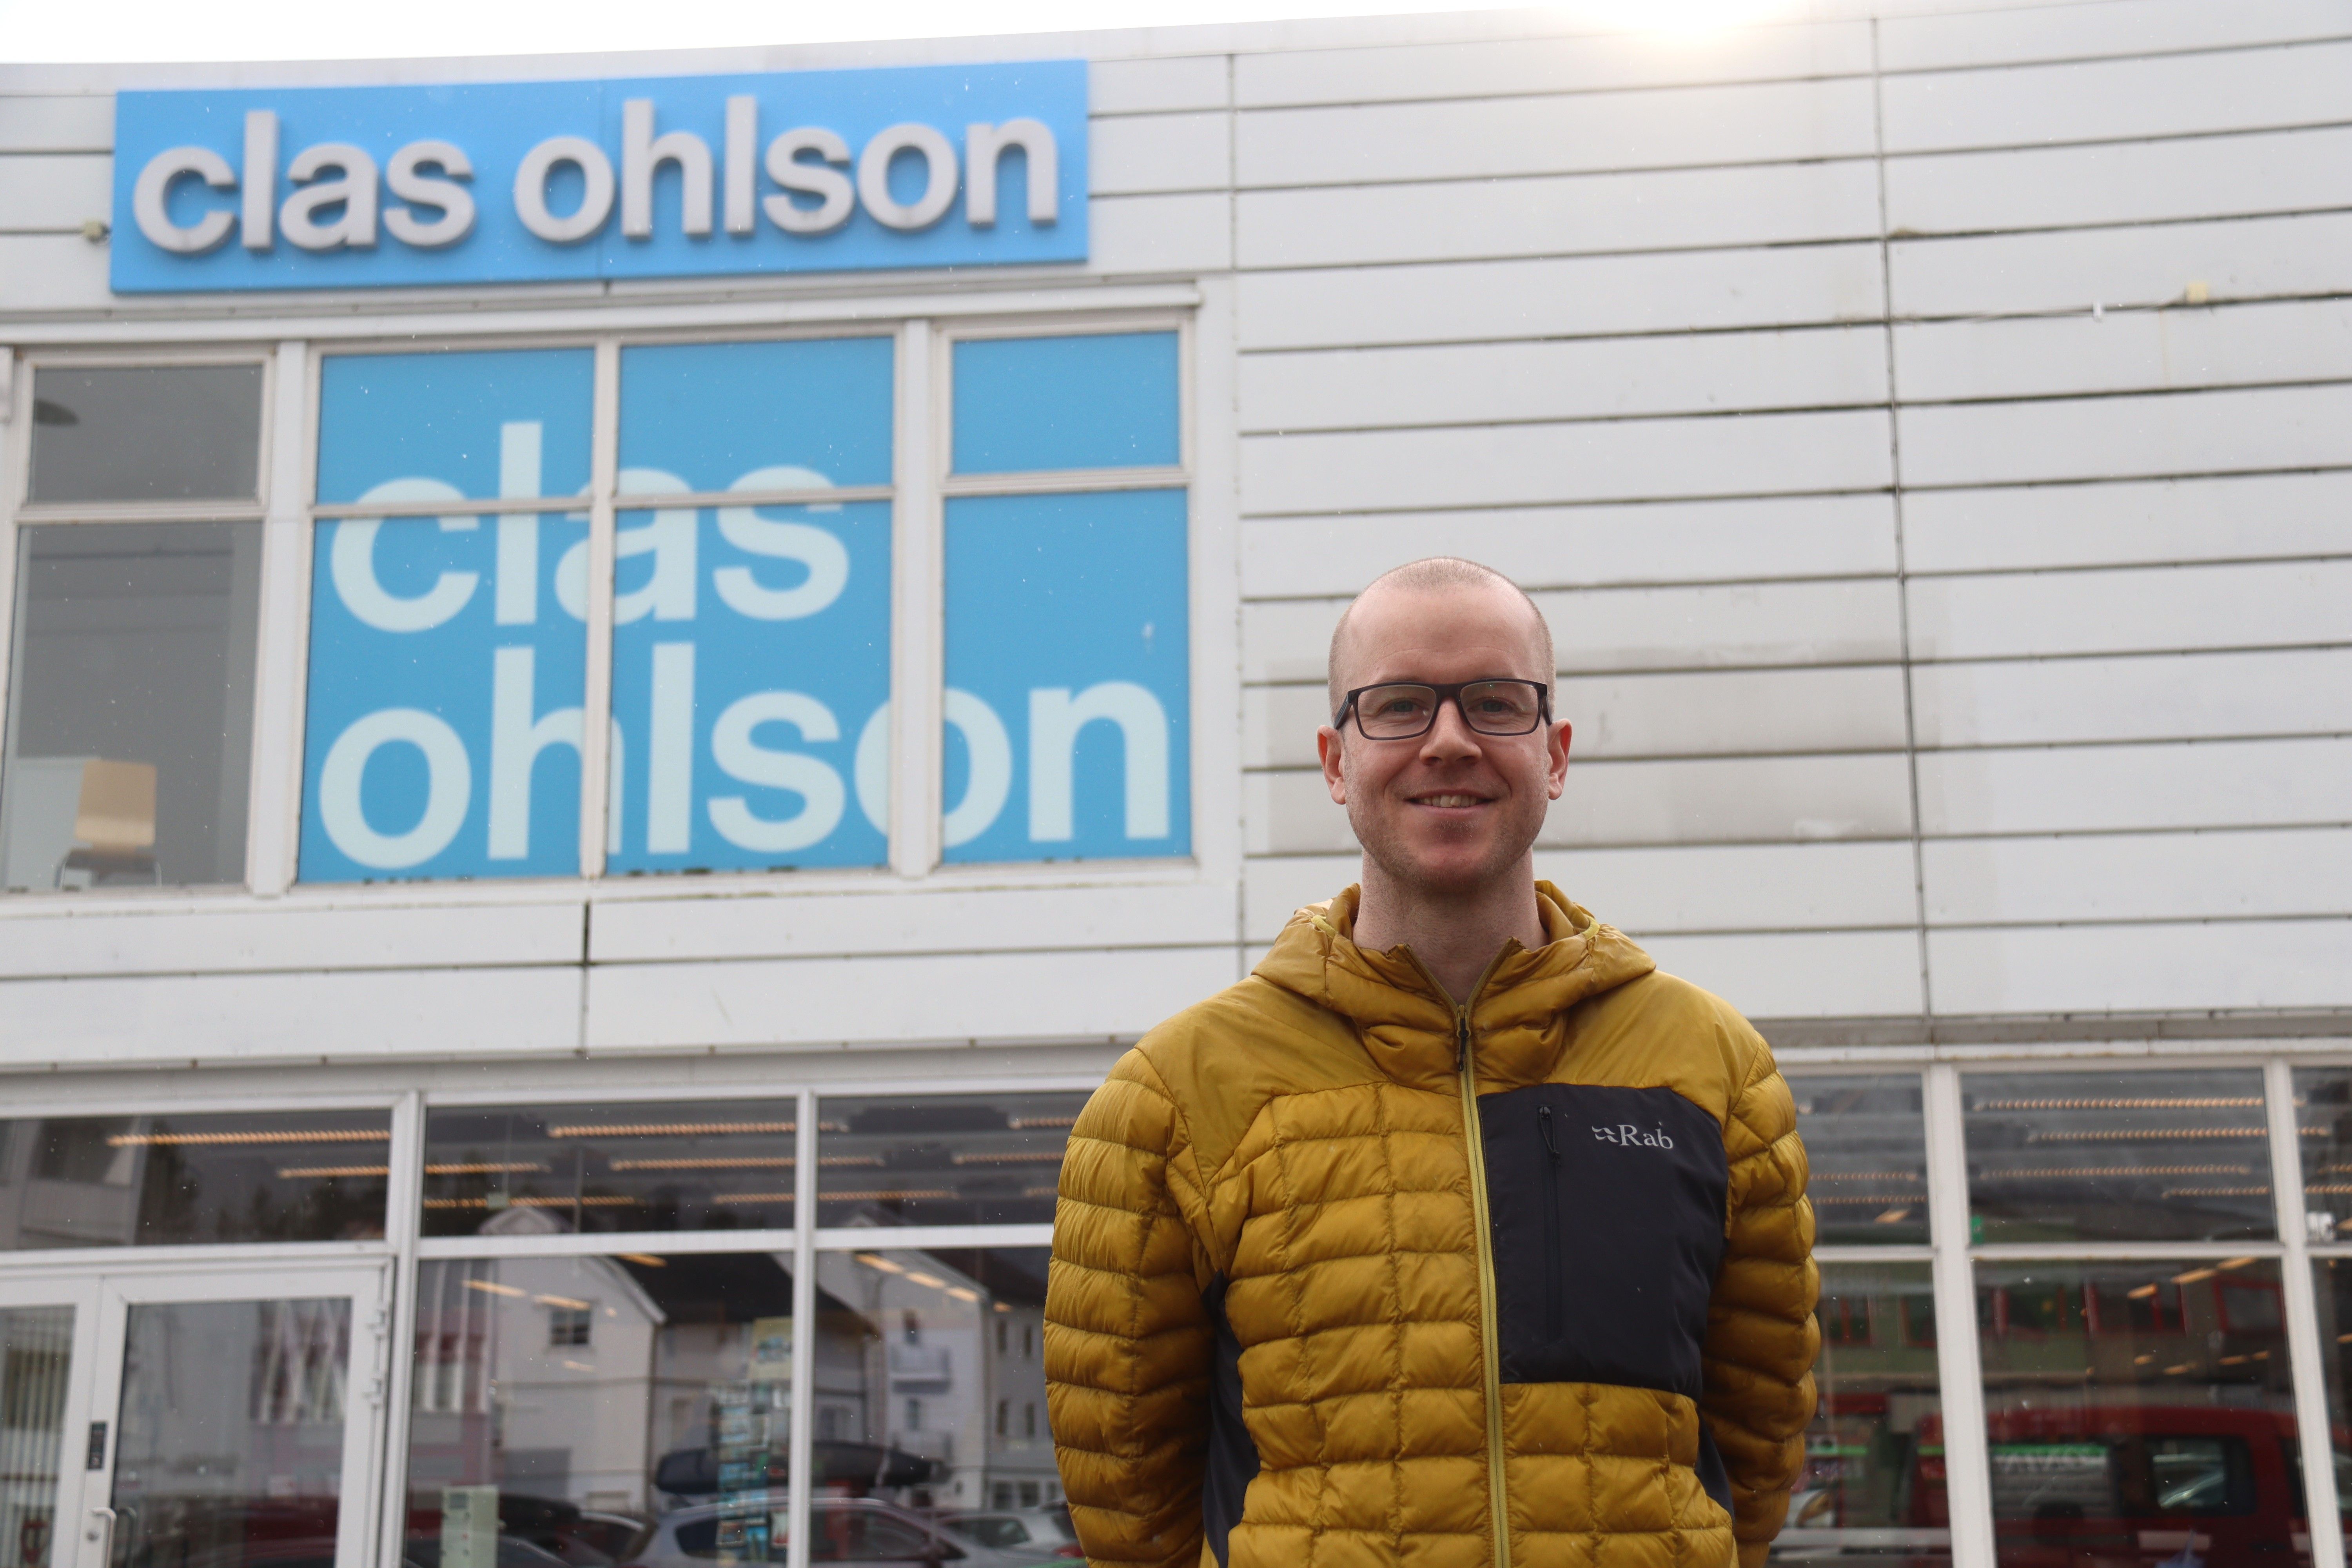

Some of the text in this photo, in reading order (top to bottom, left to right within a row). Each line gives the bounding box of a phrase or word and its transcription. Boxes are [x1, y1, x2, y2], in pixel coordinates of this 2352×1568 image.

[132, 95, 1059, 253] clas ohlson
[330, 420, 850, 633] clas
[318, 641, 1170, 869] ohlson
[1616, 1124, 1673, 1149] Rab
